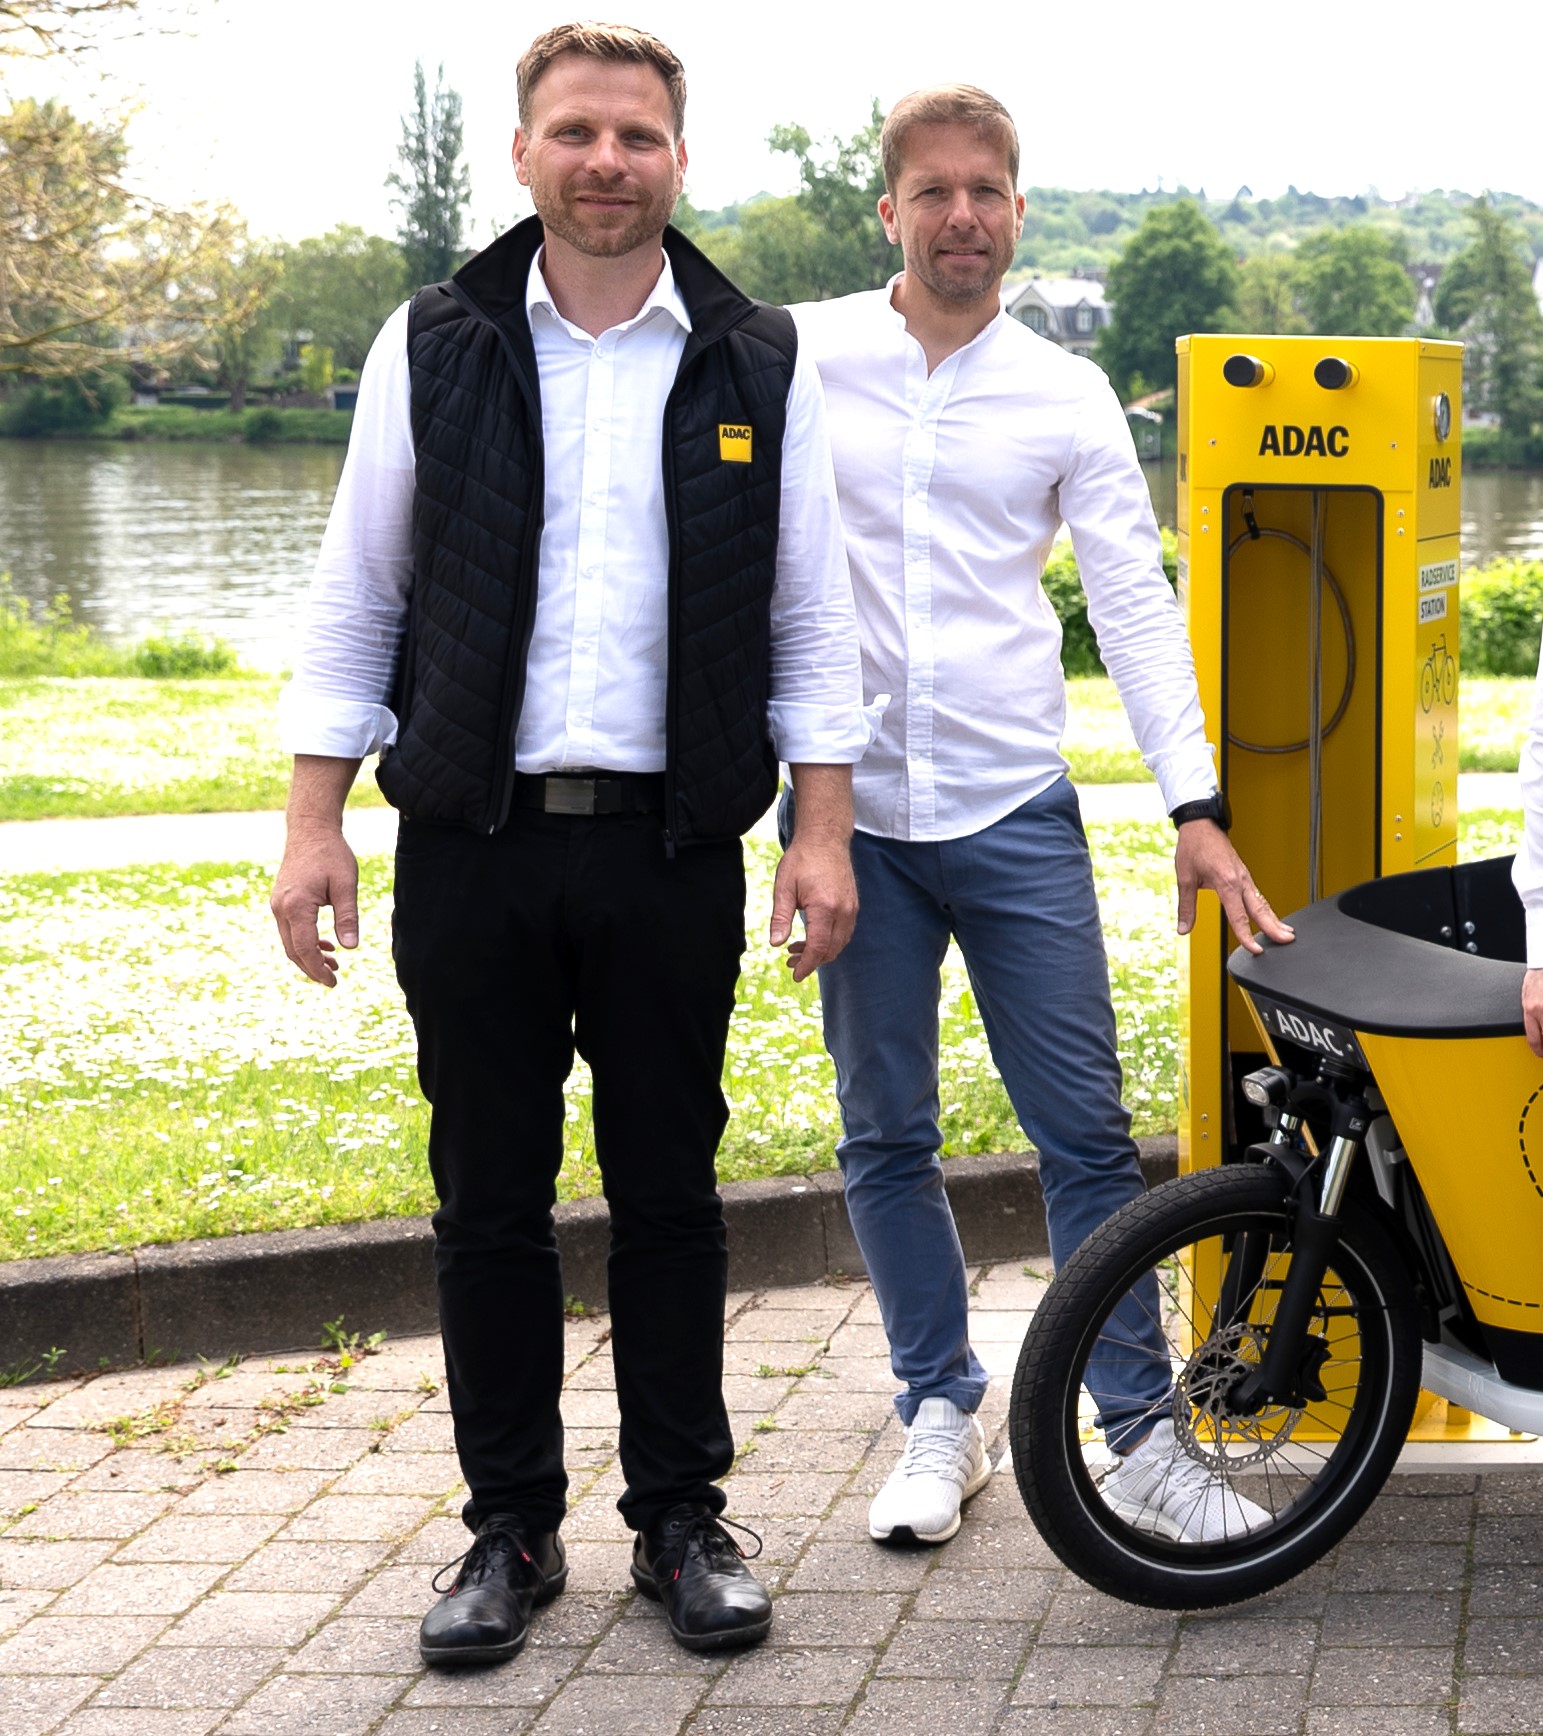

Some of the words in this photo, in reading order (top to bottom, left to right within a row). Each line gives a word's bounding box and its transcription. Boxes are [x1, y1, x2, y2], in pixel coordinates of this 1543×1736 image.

[722, 427, 751, 440] ADAC
[1258, 425, 1350, 457] ADAC
[1429, 456, 1451, 489] ADAC
[1421, 563, 1455, 588] RADSERVICE
[1421, 596, 1445, 618] STATION
[1276, 1008, 1344, 1056] ADAC
